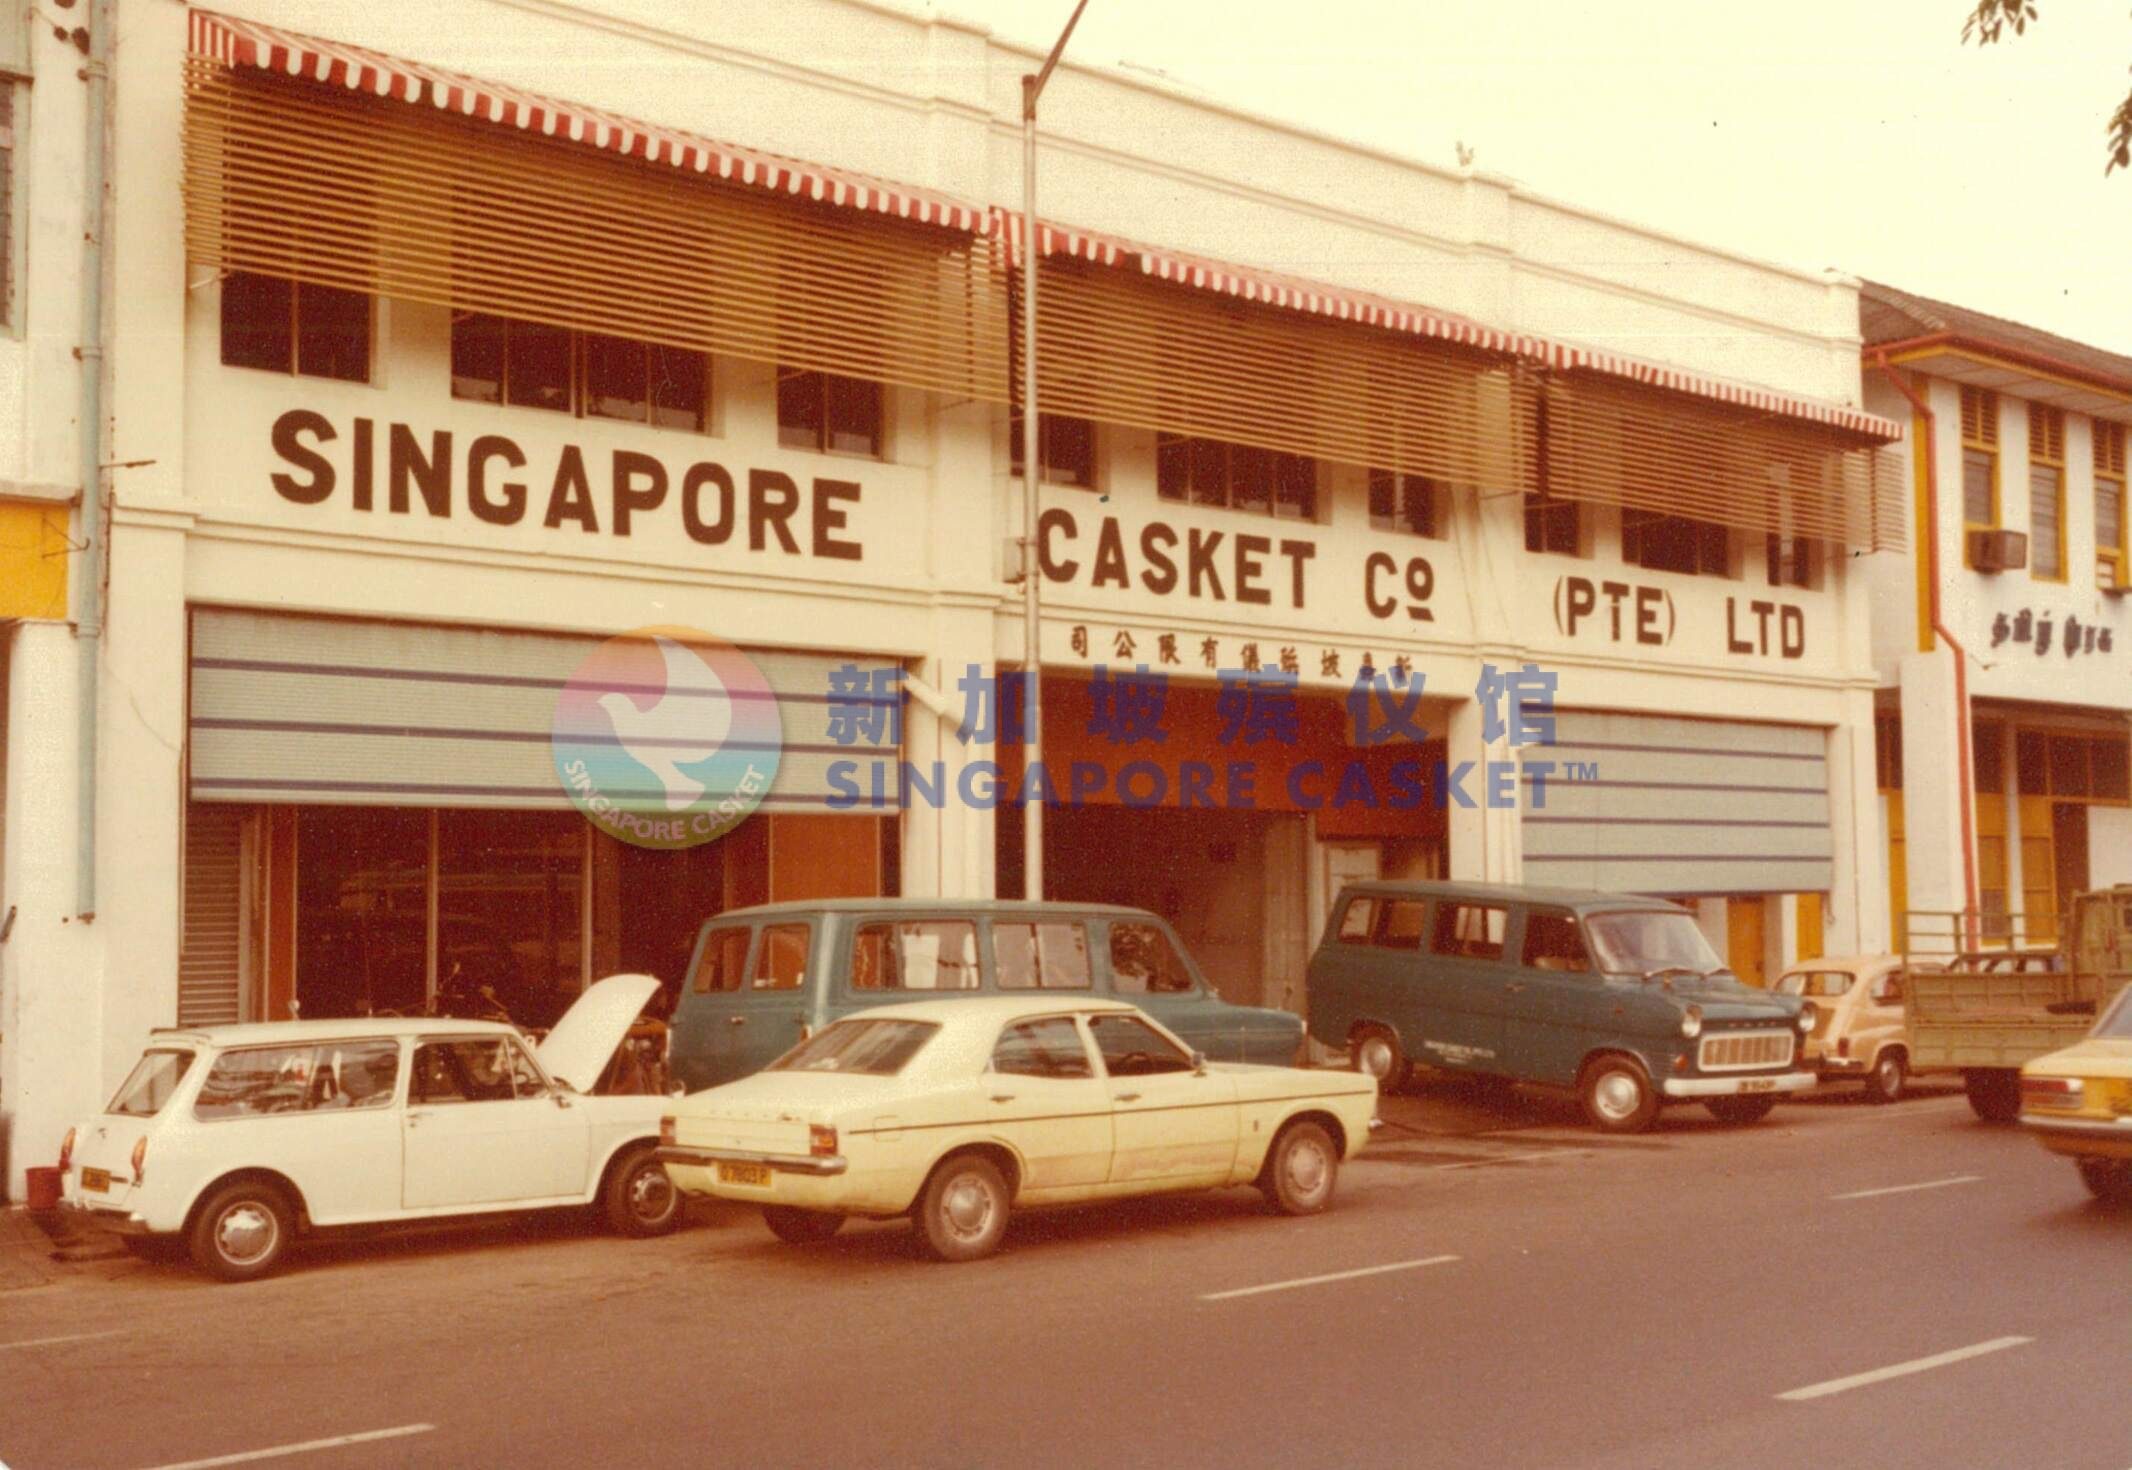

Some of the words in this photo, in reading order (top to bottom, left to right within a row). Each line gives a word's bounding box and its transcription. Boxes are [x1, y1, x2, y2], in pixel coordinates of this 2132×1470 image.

[272, 409, 862, 561] SINGAPORE
[1039, 508, 1317, 609] CASKET
[1553, 575, 1676, 646] (PTE)
[1726, 596, 1805, 659] LTD
